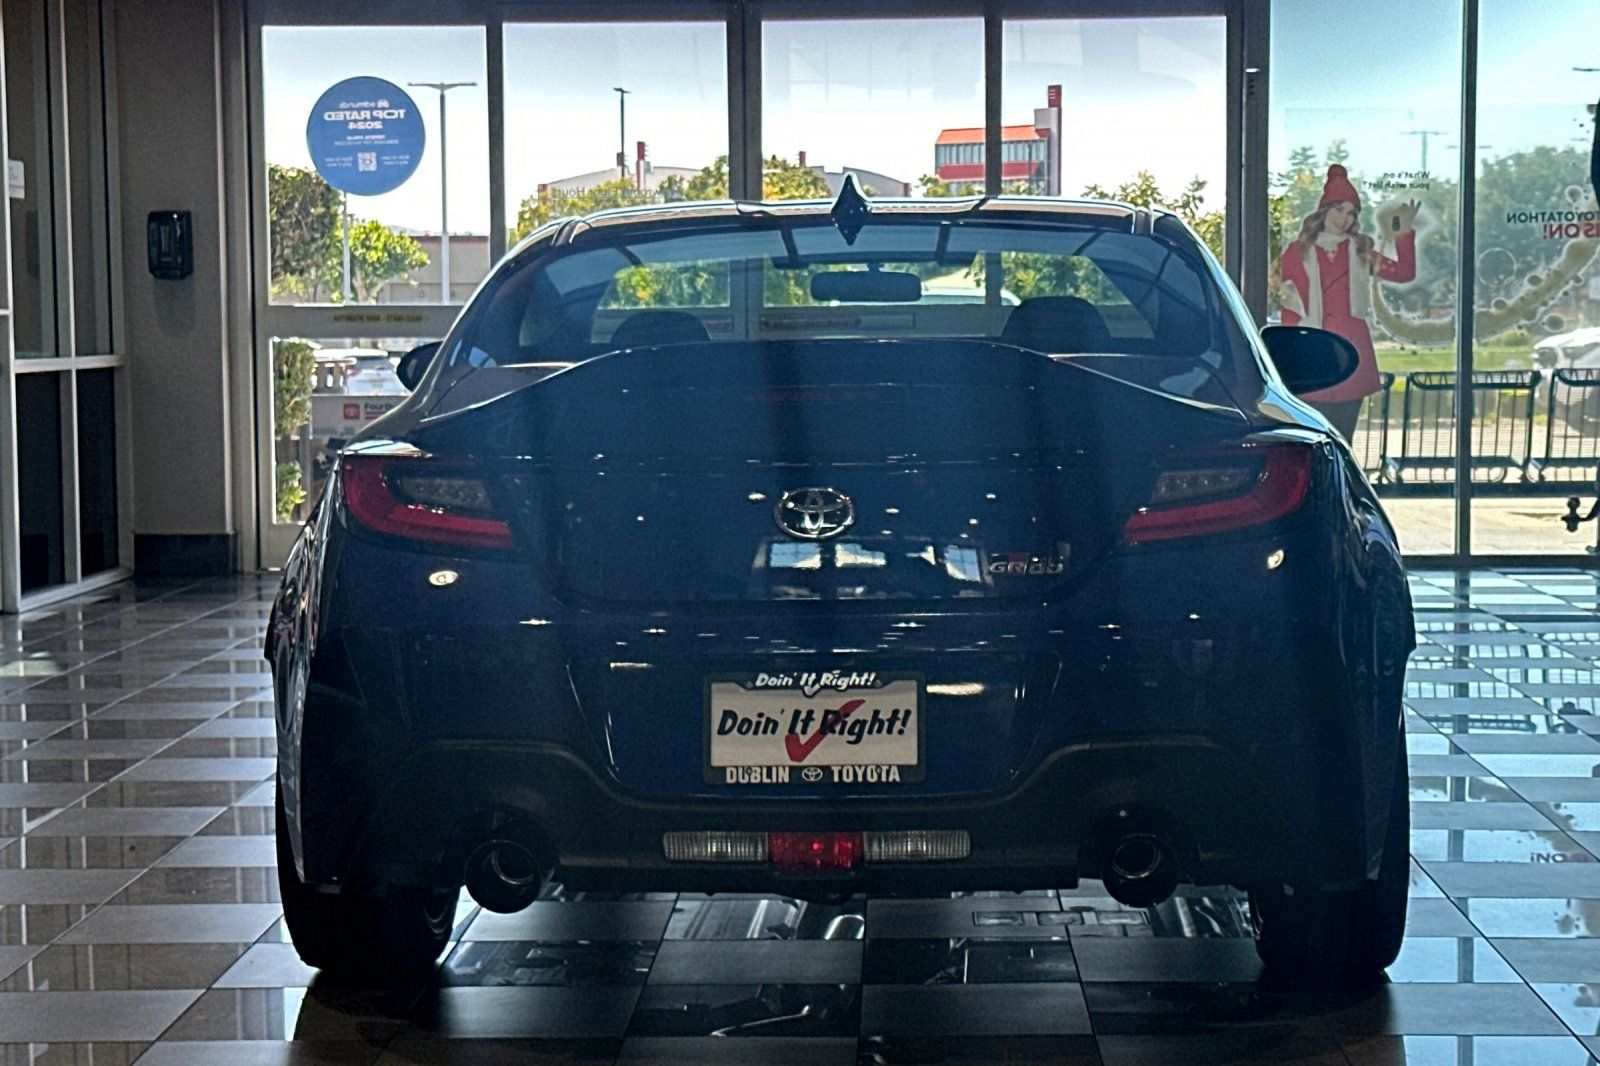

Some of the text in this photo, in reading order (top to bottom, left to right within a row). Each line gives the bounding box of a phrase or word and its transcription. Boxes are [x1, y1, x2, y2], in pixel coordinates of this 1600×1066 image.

[755, 671, 877, 691] Doin' It Right!
[717, 708, 913, 745] Doin' It Right!
[726, 766, 901, 784] DUBLIN TOYOTA
